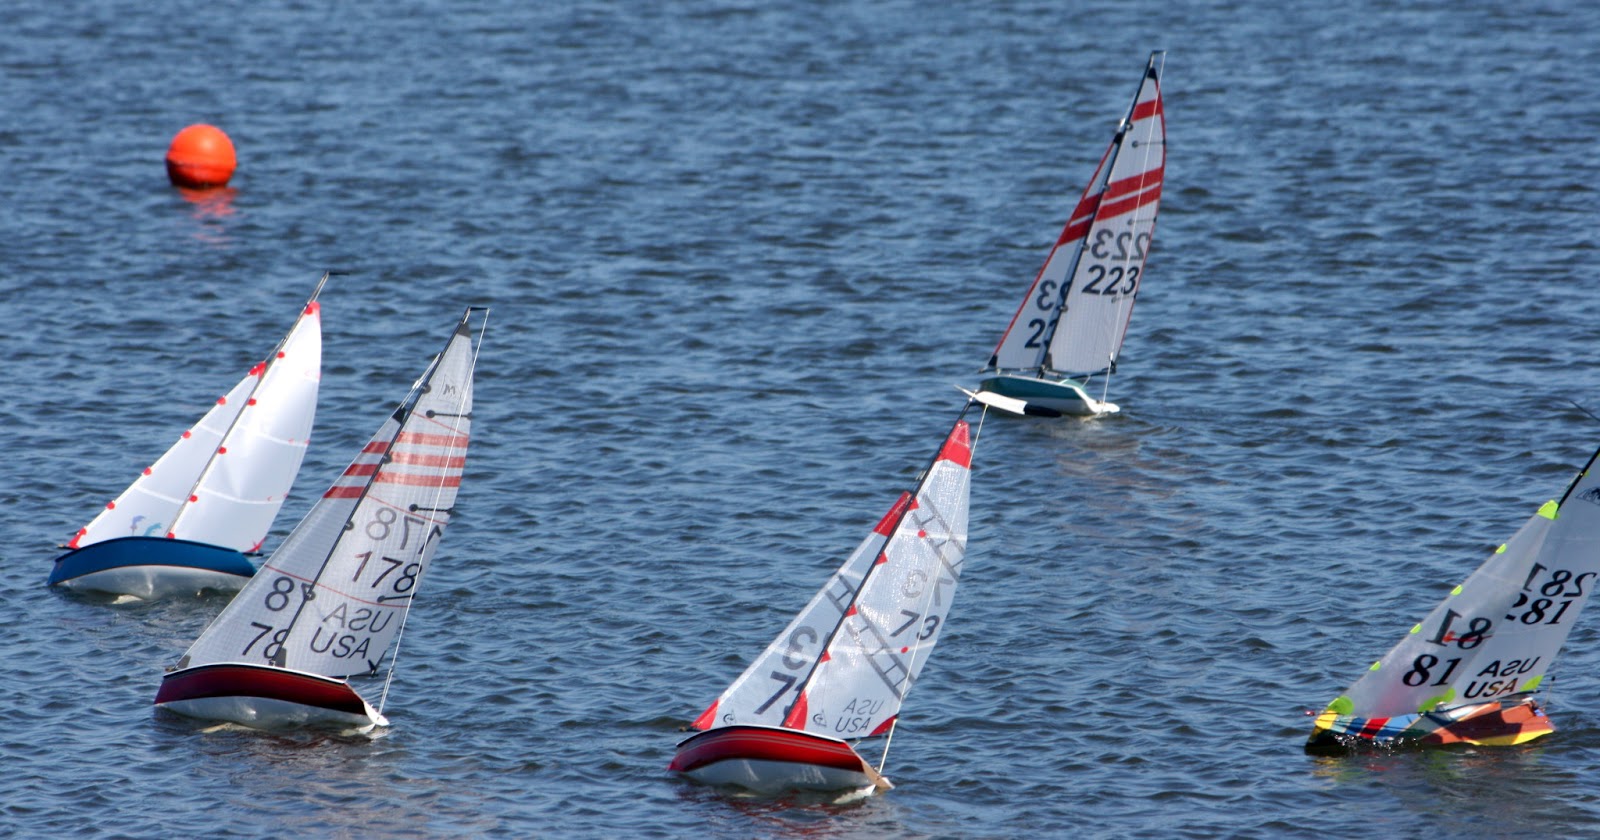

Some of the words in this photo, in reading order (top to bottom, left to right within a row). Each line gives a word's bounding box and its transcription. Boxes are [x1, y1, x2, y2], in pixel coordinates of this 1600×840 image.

[1081, 265, 1140, 295] 223
[353, 551, 422, 593] 178
[890, 609, 940, 640] 73
[310, 626, 373, 660] USA
[1402, 654, 1462, 687] 81
[1463, 679, 1516, 699] USA
[835, 716, 871, 733] USA
